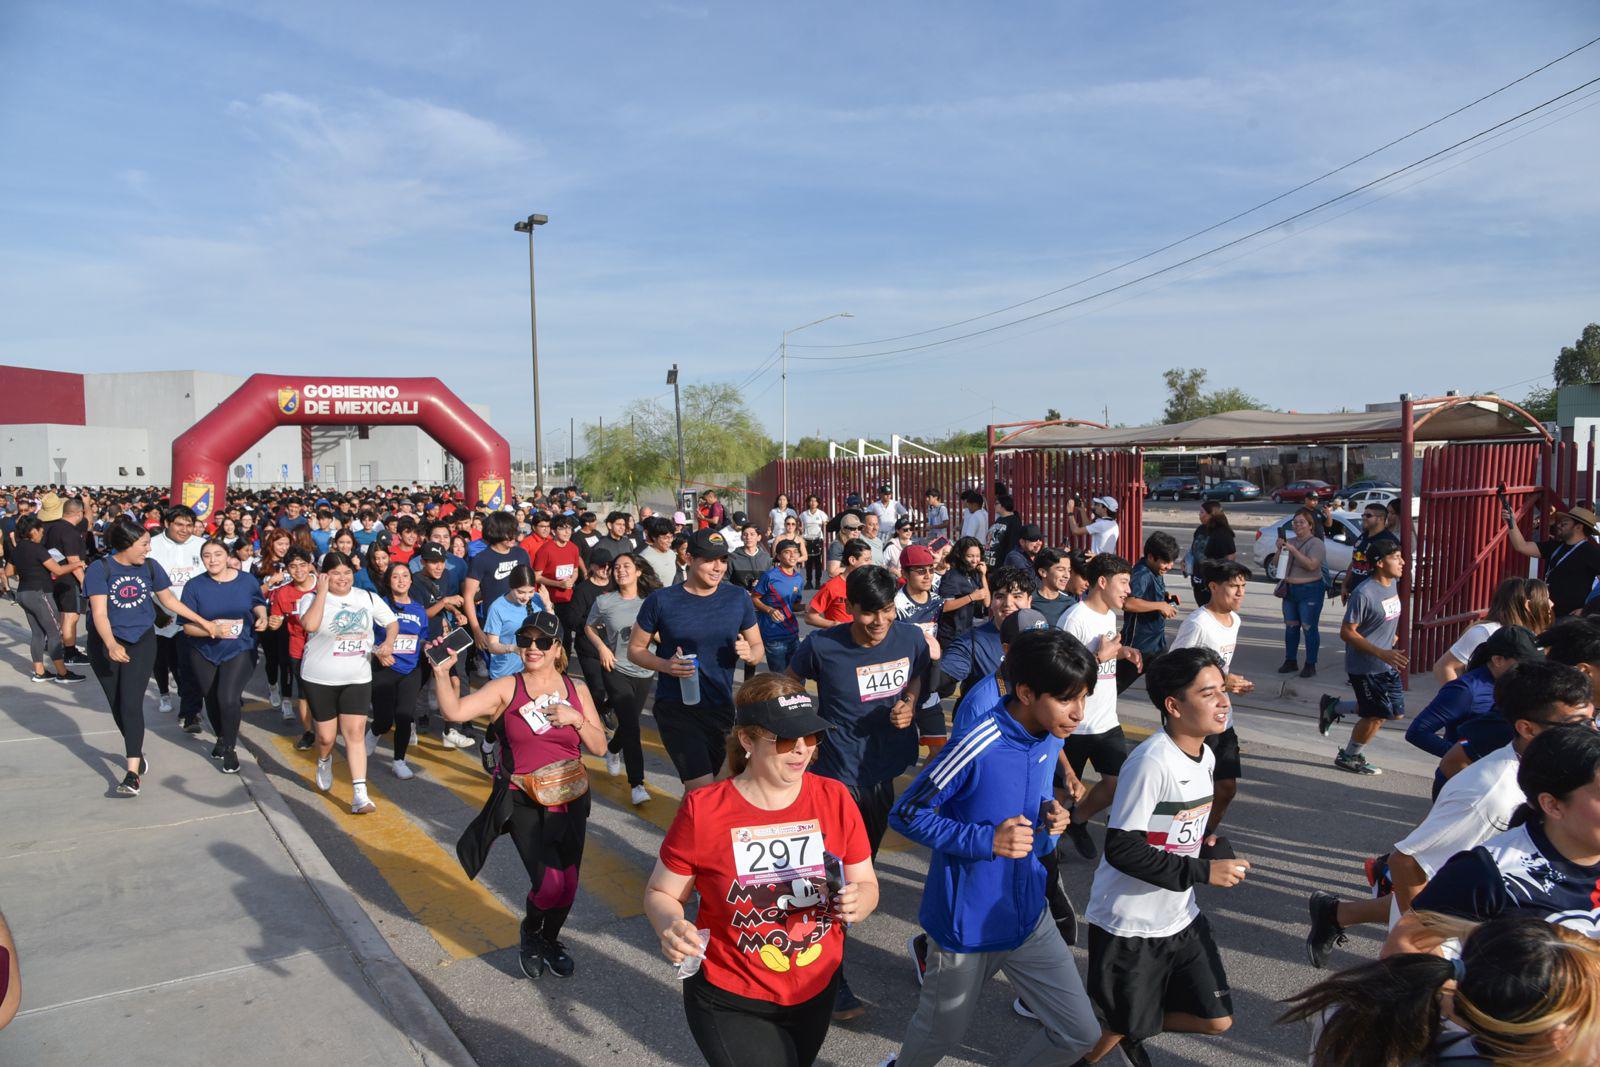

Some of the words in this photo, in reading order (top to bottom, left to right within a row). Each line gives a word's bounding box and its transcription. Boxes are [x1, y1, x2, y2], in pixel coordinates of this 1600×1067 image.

[303, 384, 400, 398] GOBIERNO
[304, 401, 330, 415] DE
[334, 401, 419, 415] MEXICALI
[111, 576, 147, 589] CHAMPION
[338, 640, 362, 652] 454
[865, 669, 904, 692] 446
[746, 835, 810, 873] 297
